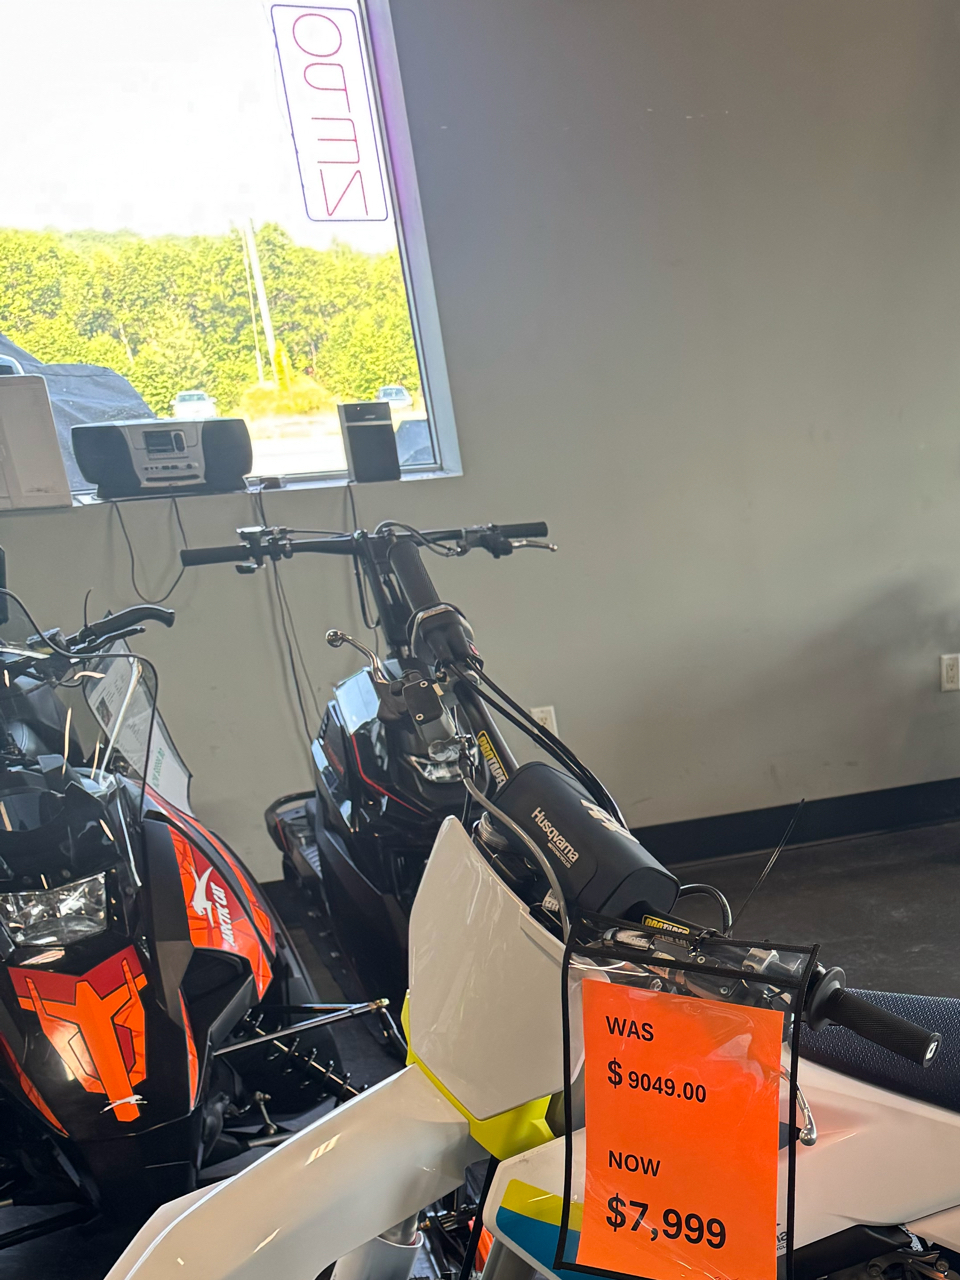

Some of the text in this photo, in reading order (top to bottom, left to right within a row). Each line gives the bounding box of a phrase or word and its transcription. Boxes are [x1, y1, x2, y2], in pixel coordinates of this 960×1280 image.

[531, 807, 579, 863] Husqvarna
[210, 881, 236, 947] ARCTIC CAT
[605, 1015, 654, 1042] WAS
[607, 1057, 707, 1103] $ 9049.00
[608, 1150, 661, 1177] NOW
[606, 1192, 727, 1250] $7,999
